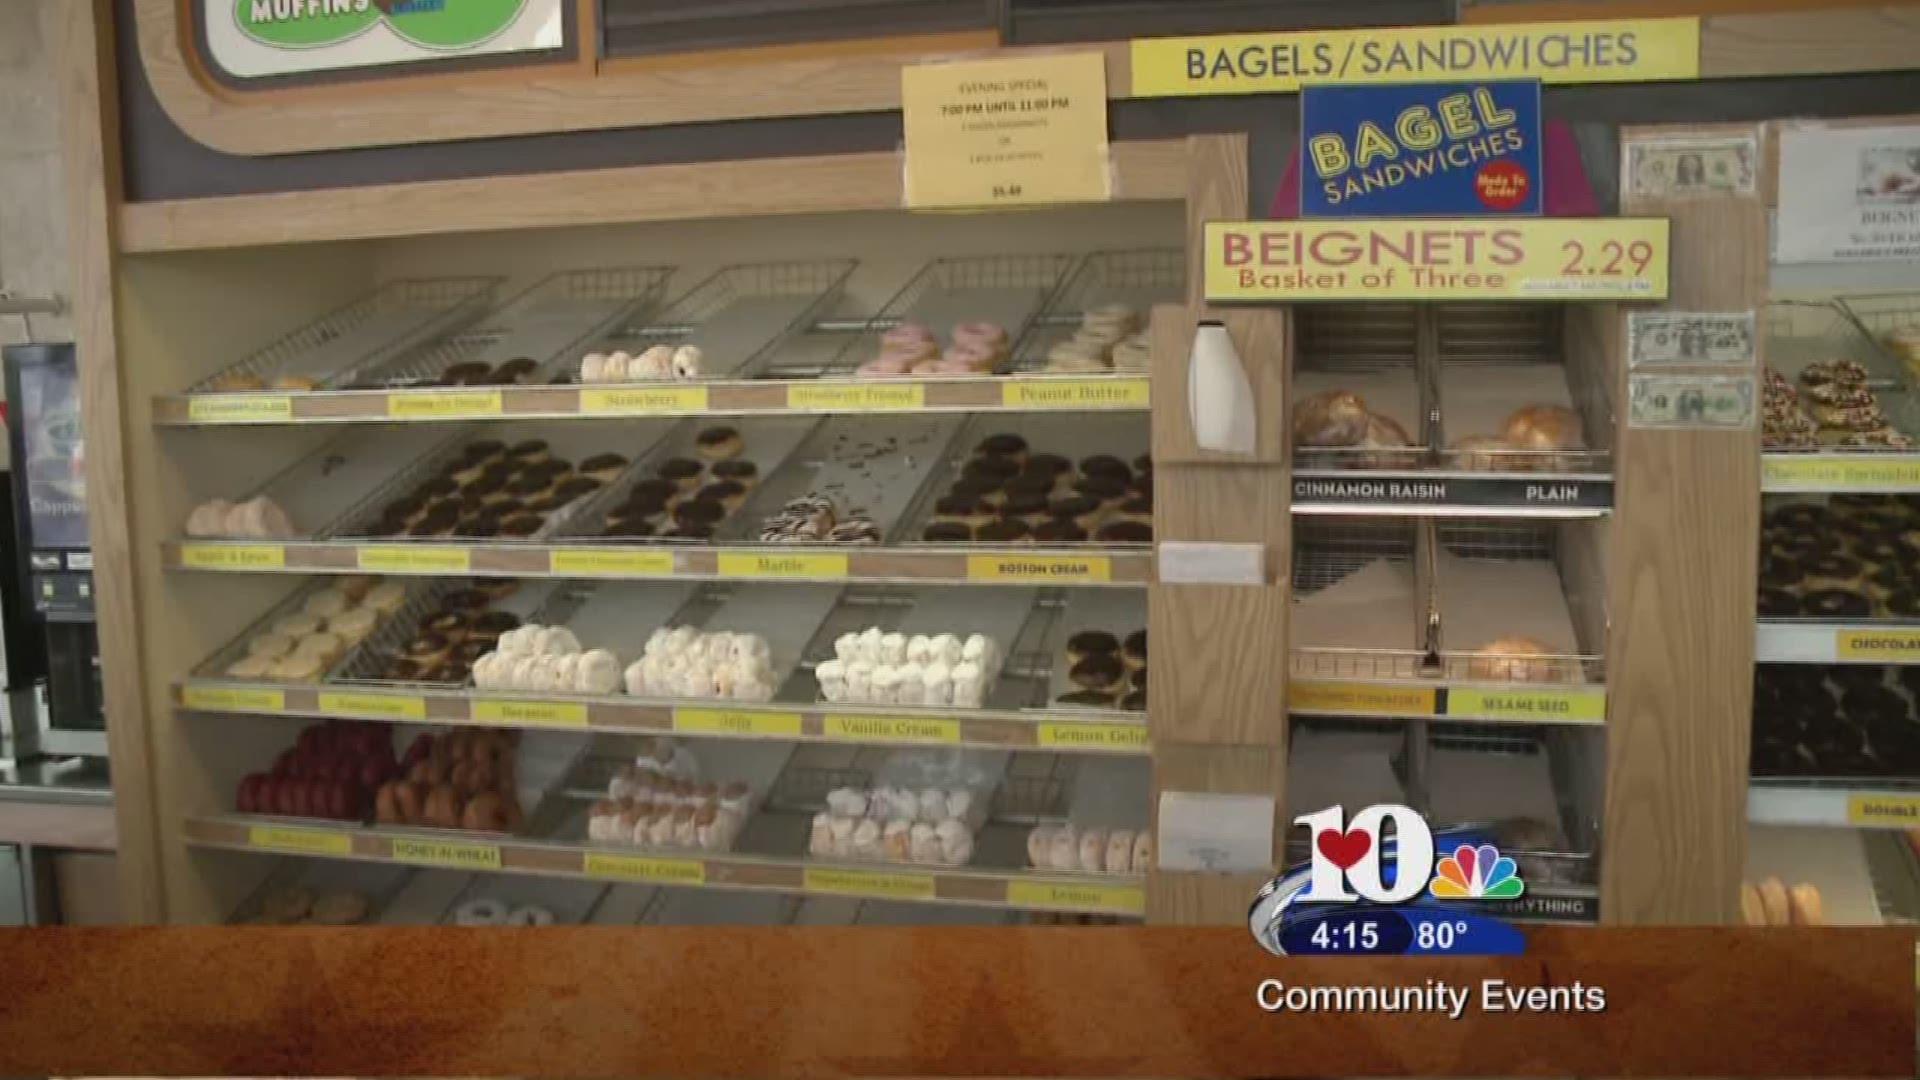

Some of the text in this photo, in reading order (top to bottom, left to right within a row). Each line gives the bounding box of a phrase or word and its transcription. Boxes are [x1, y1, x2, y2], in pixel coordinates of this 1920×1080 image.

[1186, 33, 1638, 79] BAGELS/SANDWICHES
[965, 103, 984, 115] PM
[986, 101, 1017, 114] UNTIL
[1051, 97, 1070, 110] PM
[1310, 87, 1516, 178] BAGEL
[1323, 127, 1523, 204] SANDWICHES
[1223, 229, 1525, 266] BEIGNETS
[1560, 239, 1654, 277] 2.29
[1239, 268, 1347, 289] Basket
[1360, 267, 1395, 289] of
[1410, 268, 1504, 289] Three
[1020, 386, 1132, 401] Peanut Butter
[1294, 482, 1447, 500] CINNAMON RAISIN
[1526, 485, 1579, 502] PLAIN
[998, 563, 1089, 575] BOSTON CREAM
[1482, 696, 1570, 713] SESAME SEED
[840, 719, 943, 738] Vanilla Cream
